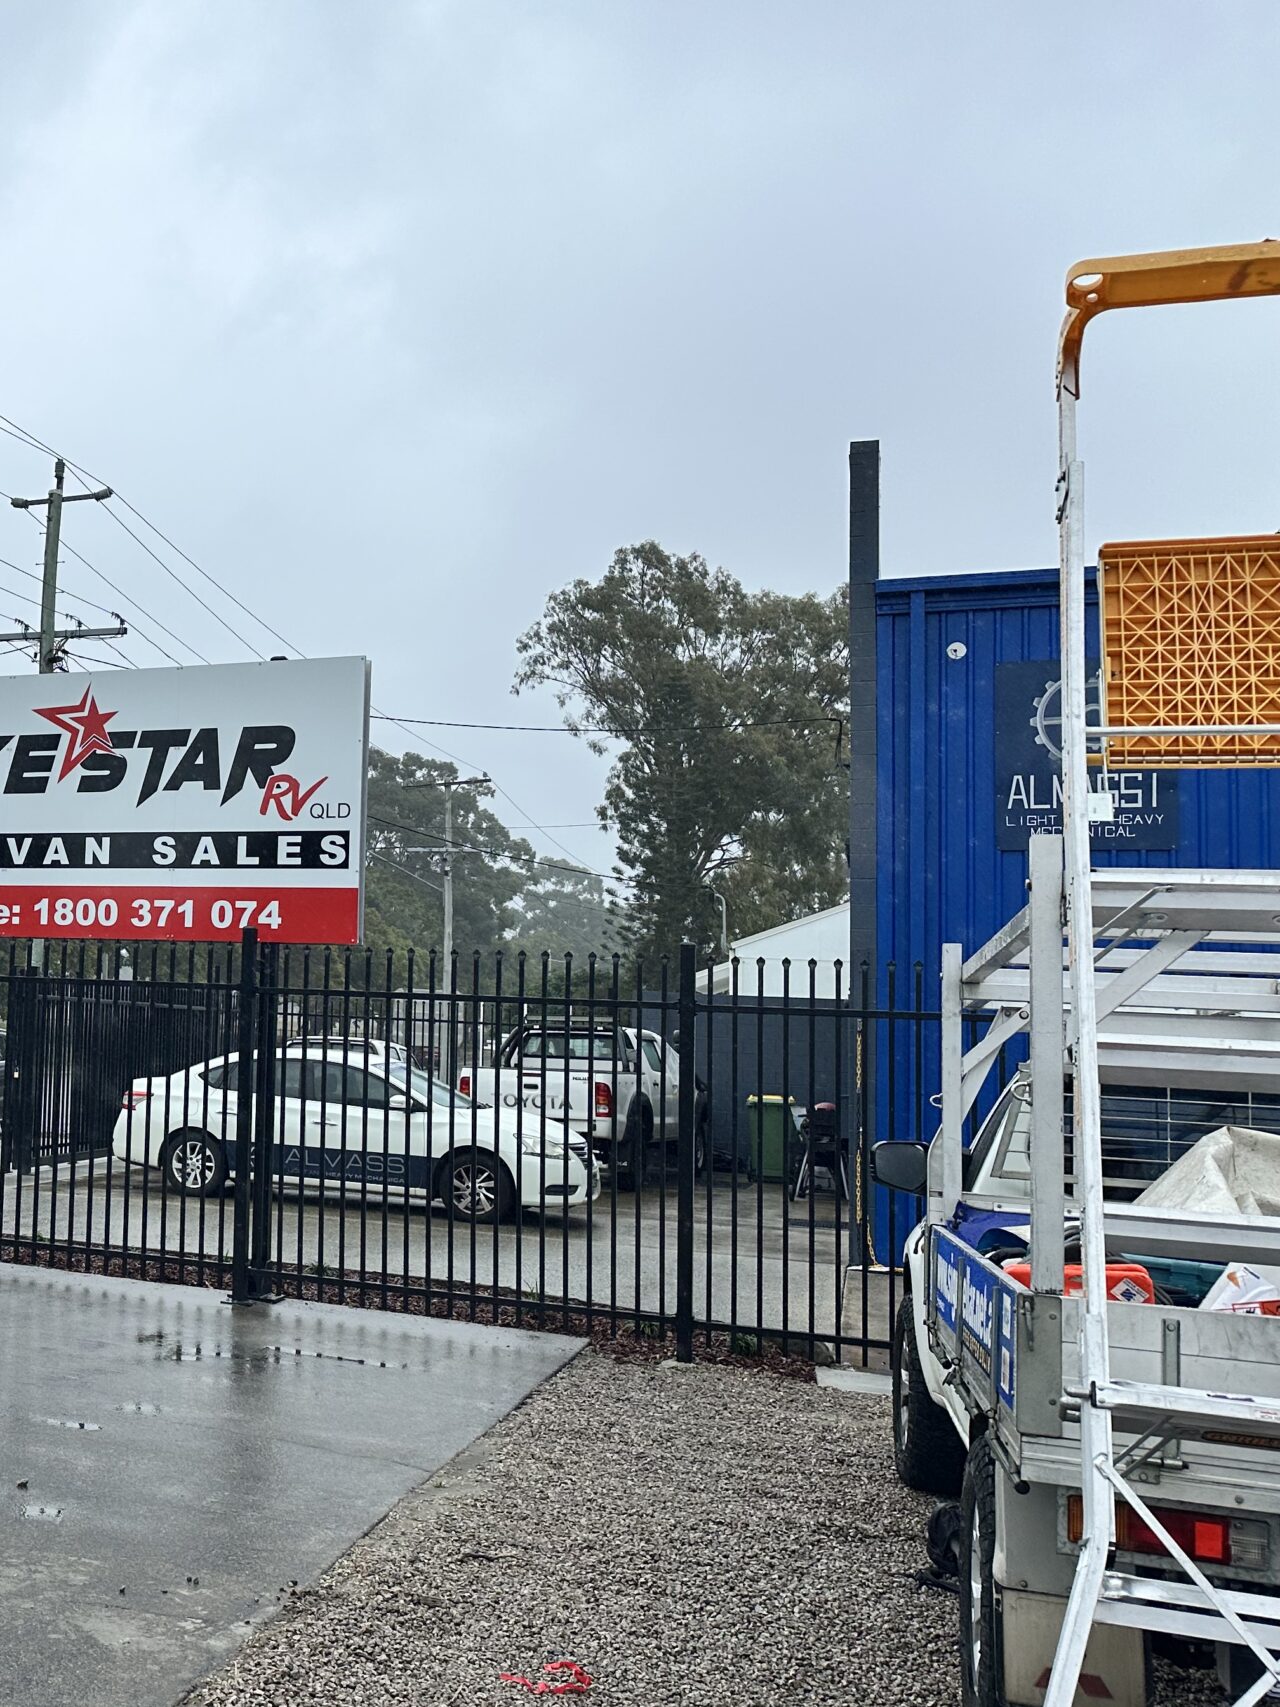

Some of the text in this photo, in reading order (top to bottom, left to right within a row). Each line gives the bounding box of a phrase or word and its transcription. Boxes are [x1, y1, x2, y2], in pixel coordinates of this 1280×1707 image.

[259, 774, 351, 821] RV QLD
[1007, 772, 1158, 810] ALMSSI
[1005, 814, 1058, 828] LIGHT
[1112, 813, 1164, 826] HEAVY
[1030, 825, 1136, 838] MECNICAL
[152, 833, 347, 866] SALES
[33, 898, 118, 926] 1800
[131, 898, 194, 928] 371
[210, 899, 282, 930] 074
[326, 1171, 353, 1179] HEAY
